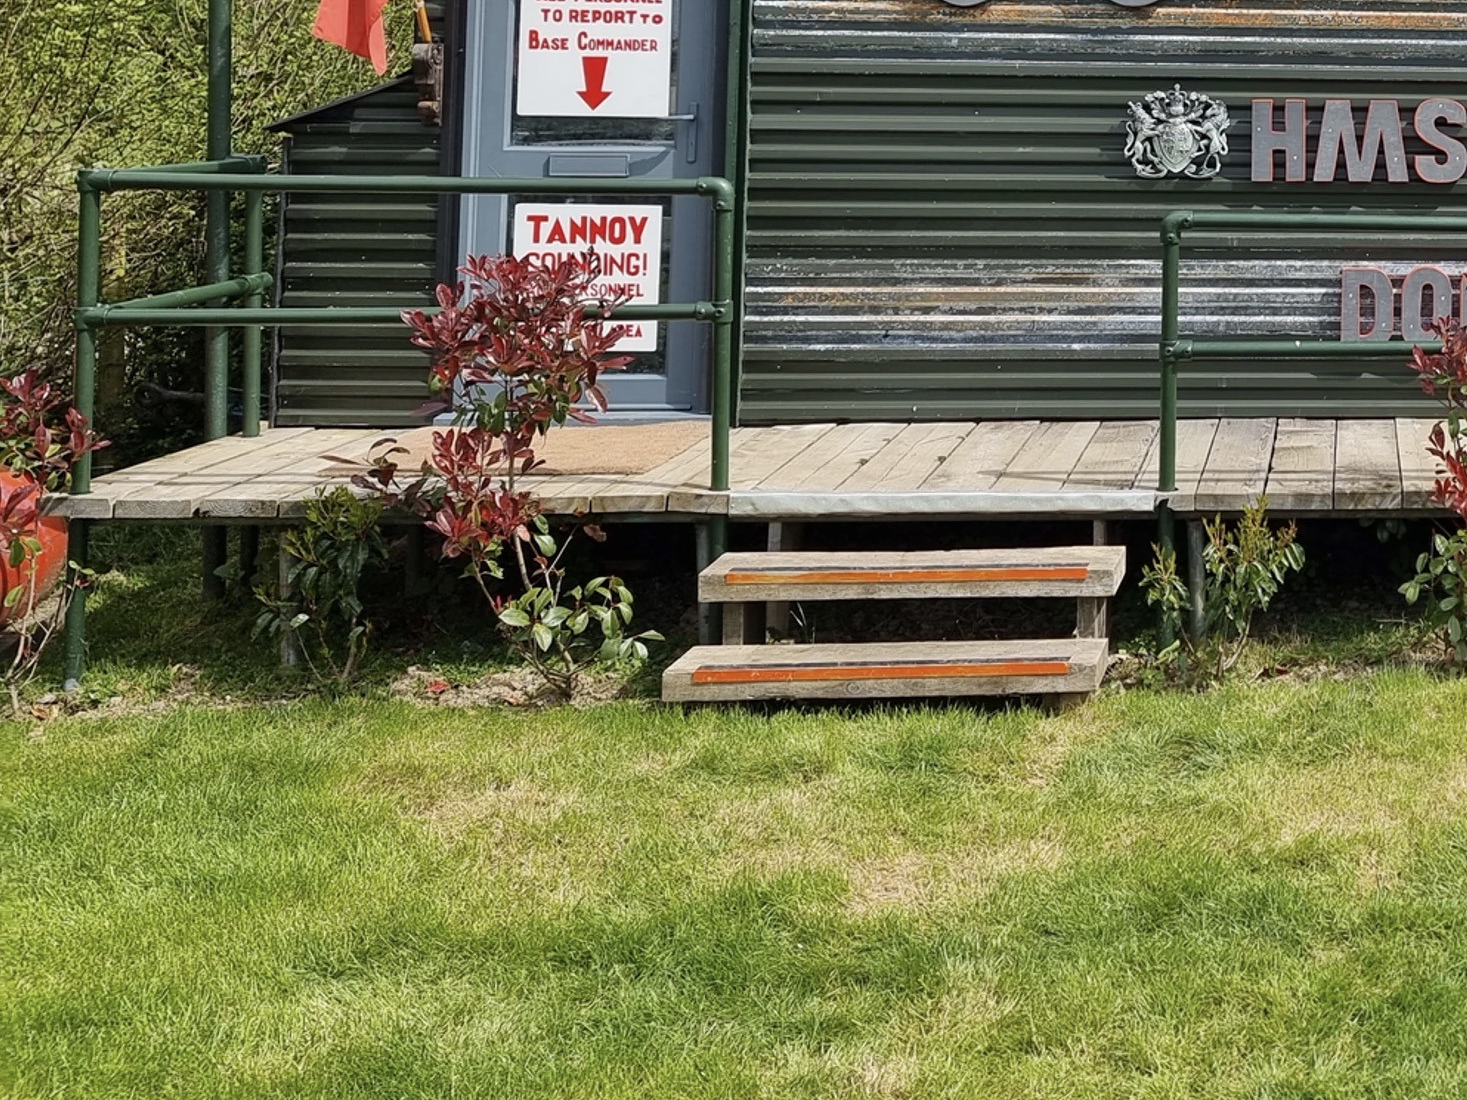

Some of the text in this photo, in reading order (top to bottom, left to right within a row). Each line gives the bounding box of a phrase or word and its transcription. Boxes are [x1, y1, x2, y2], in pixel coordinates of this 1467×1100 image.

[541, 8, 663, 25] TO REPORT TO
[1251, 98, 1467, 185] HMS
[526, 215, 649, 245] TANNOY
